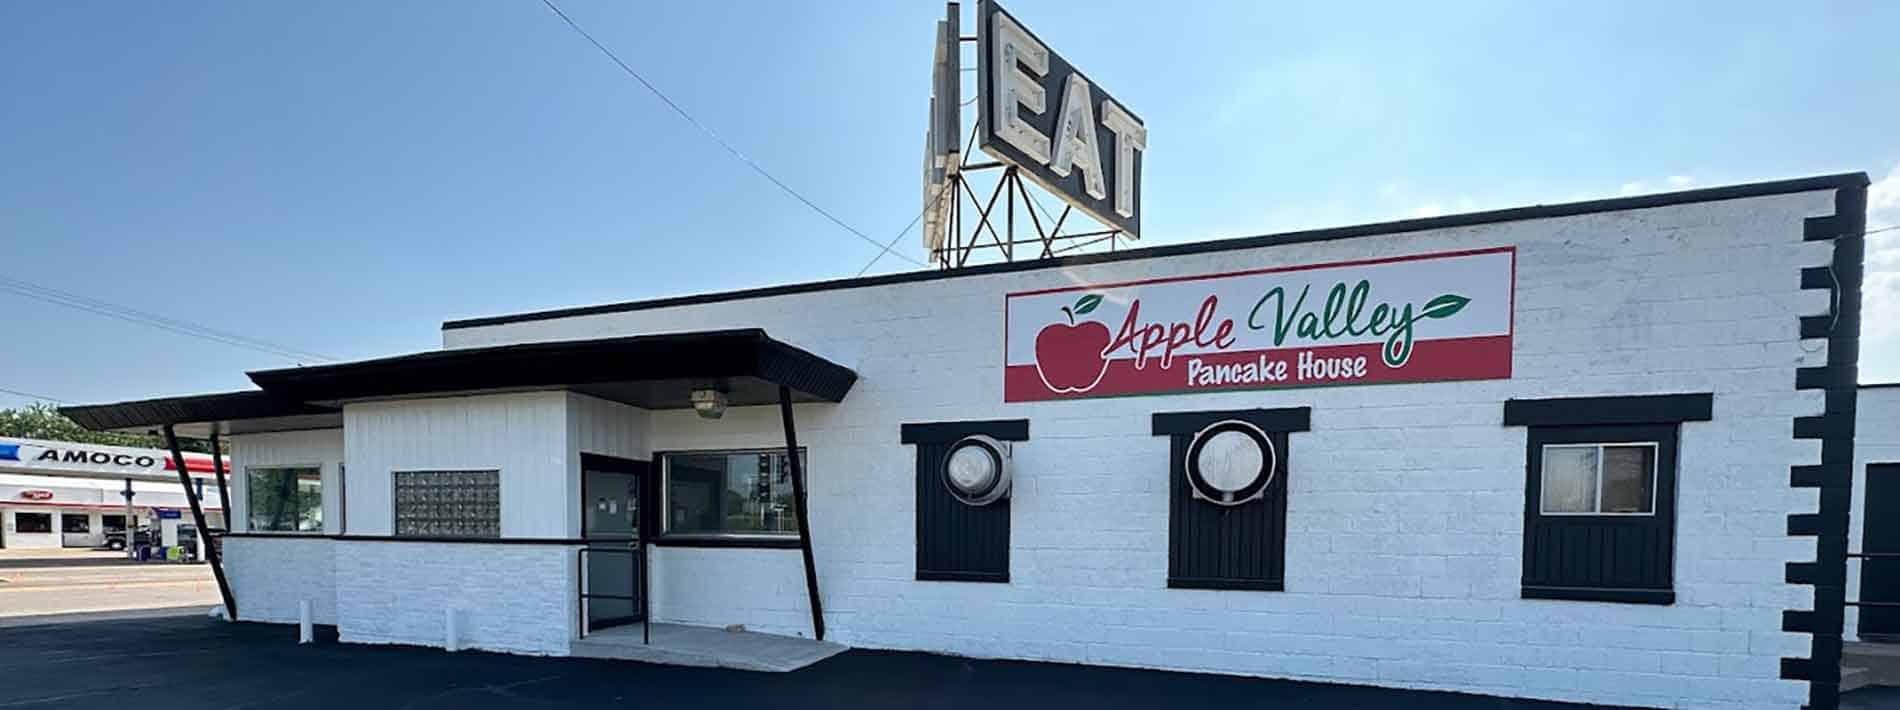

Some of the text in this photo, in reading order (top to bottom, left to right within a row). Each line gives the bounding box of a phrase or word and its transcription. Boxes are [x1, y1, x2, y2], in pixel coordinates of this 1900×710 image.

[993, 12, 1147, 218] EAT
[1104, 279, 1421, 369] Apple Valley
[1187, 350, 1367, 387] Pancake House
[38, 449, 154, 468] AMOCO
